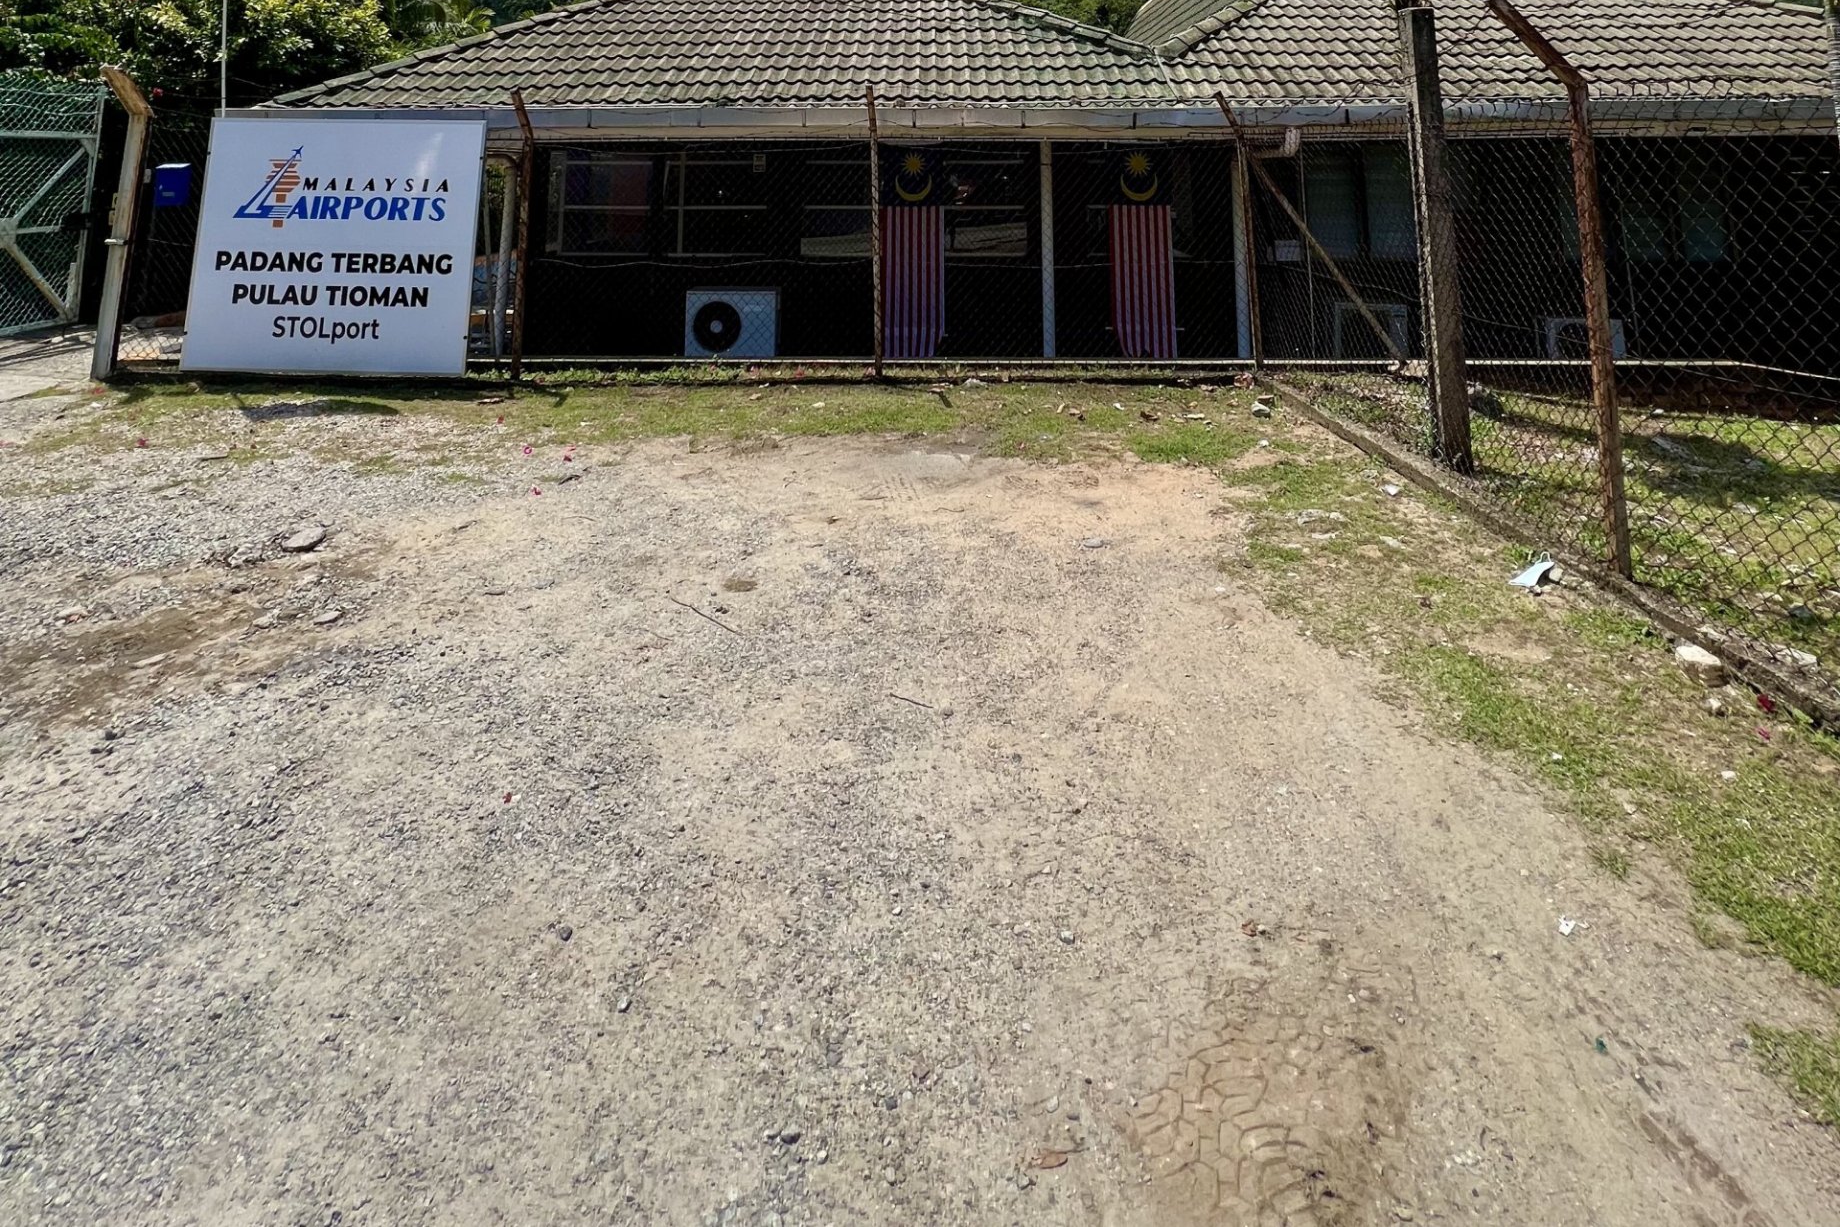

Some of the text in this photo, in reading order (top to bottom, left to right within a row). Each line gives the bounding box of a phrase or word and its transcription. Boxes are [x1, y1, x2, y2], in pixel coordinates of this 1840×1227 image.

[302, 177, 449, 193] MALAYSIA
[286, 196, 446, 221] AIRPORTS
[215, 251, 453, 274] PADANG TERBANG
[231, 284, 429, 307] PULAU TIOMAN
[272, 316, 379, 344] STOLport
